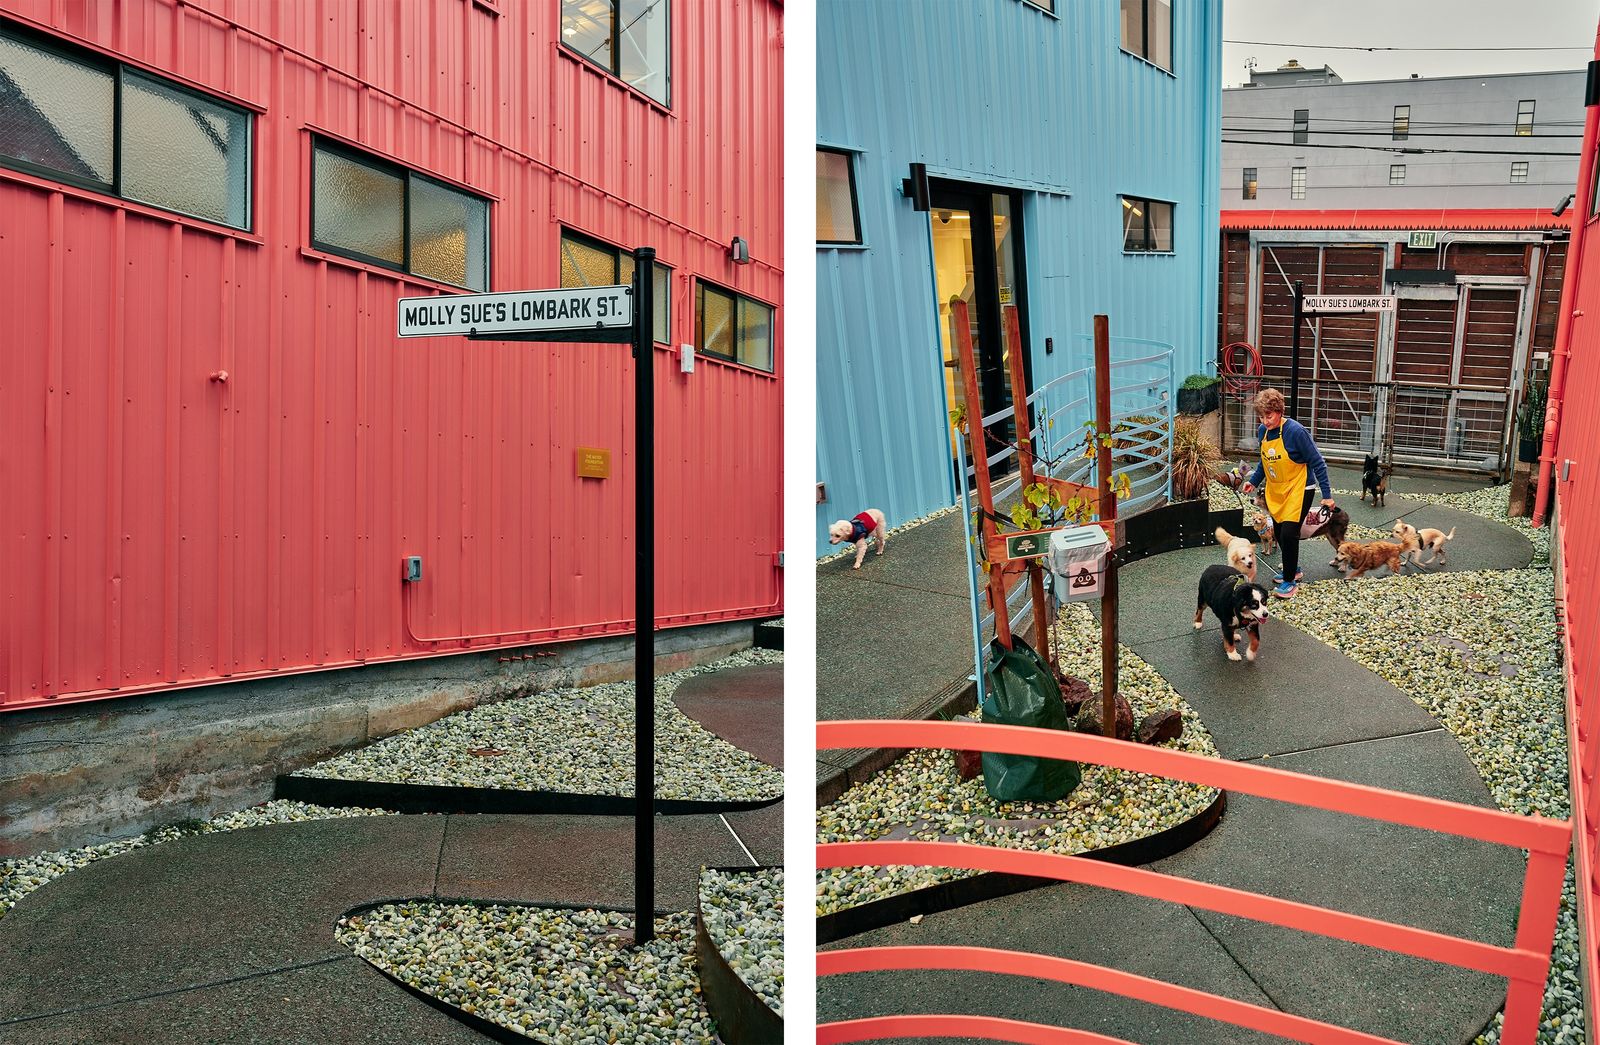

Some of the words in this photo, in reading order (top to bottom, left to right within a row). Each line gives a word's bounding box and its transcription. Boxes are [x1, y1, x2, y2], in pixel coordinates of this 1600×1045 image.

[1413, 232, 1433, 246] EXIT
[1305, 298, 1327, 308] MOLLY
[1328, 298, 1347, 308] SUE'S
[1348, 298, 1381, 308] LOMBARK
[1381, 298, 1392, 308] ST.
[405, 304, 456, 327] MOLLY
[460, 302, 507, 324] SUE'S
[512, 297, 592, 322] LOMBARK
[597, 295, 623, 317] ST.
